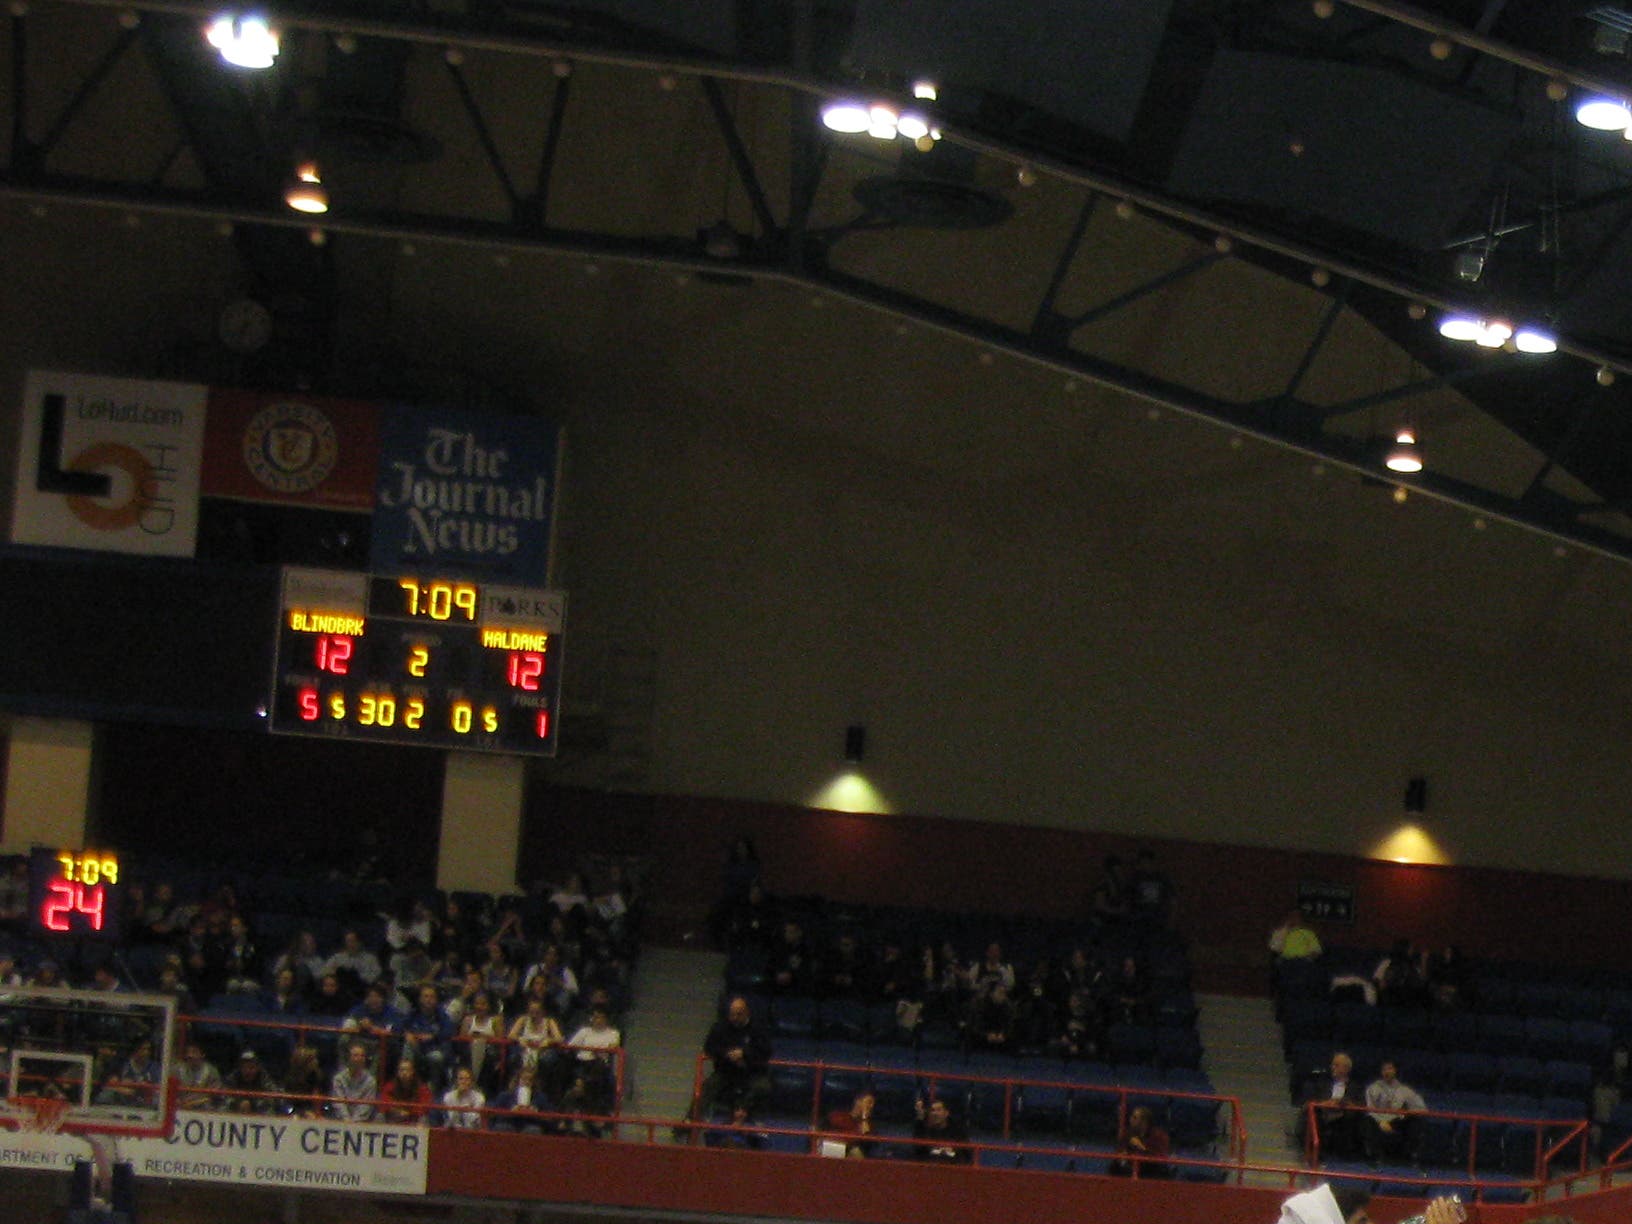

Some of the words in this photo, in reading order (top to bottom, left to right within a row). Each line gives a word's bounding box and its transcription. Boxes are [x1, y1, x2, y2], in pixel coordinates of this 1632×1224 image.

[423, 427, 510, 479] The
[379, 459, 549, 521] Journal
[403, 506, 519, 556] News
[399, 577, 477, 622] 7:09
[290, 610, 366, 637] BLINDBRK
[482, 628, 549, 654] HALDANE
[315, 635, 354, 676] 12
[408, 647, 430, 678] 2
[506, 653, 546, 693] 12
[297, 688, 321, 722] 5
[357, 694, 397, 728] 30
[403, 698, 426, 731] 2
[57, 852, 119, 886] 7:09
[45, 883, 104, 932] 24
[300, 1127, 421, 1162] CENTER
[145, 1159, 231, 1178] RECREATION
[239, 1166, 248, 1178] &
[255, 1166, 361, 1187] CONSERVATION
